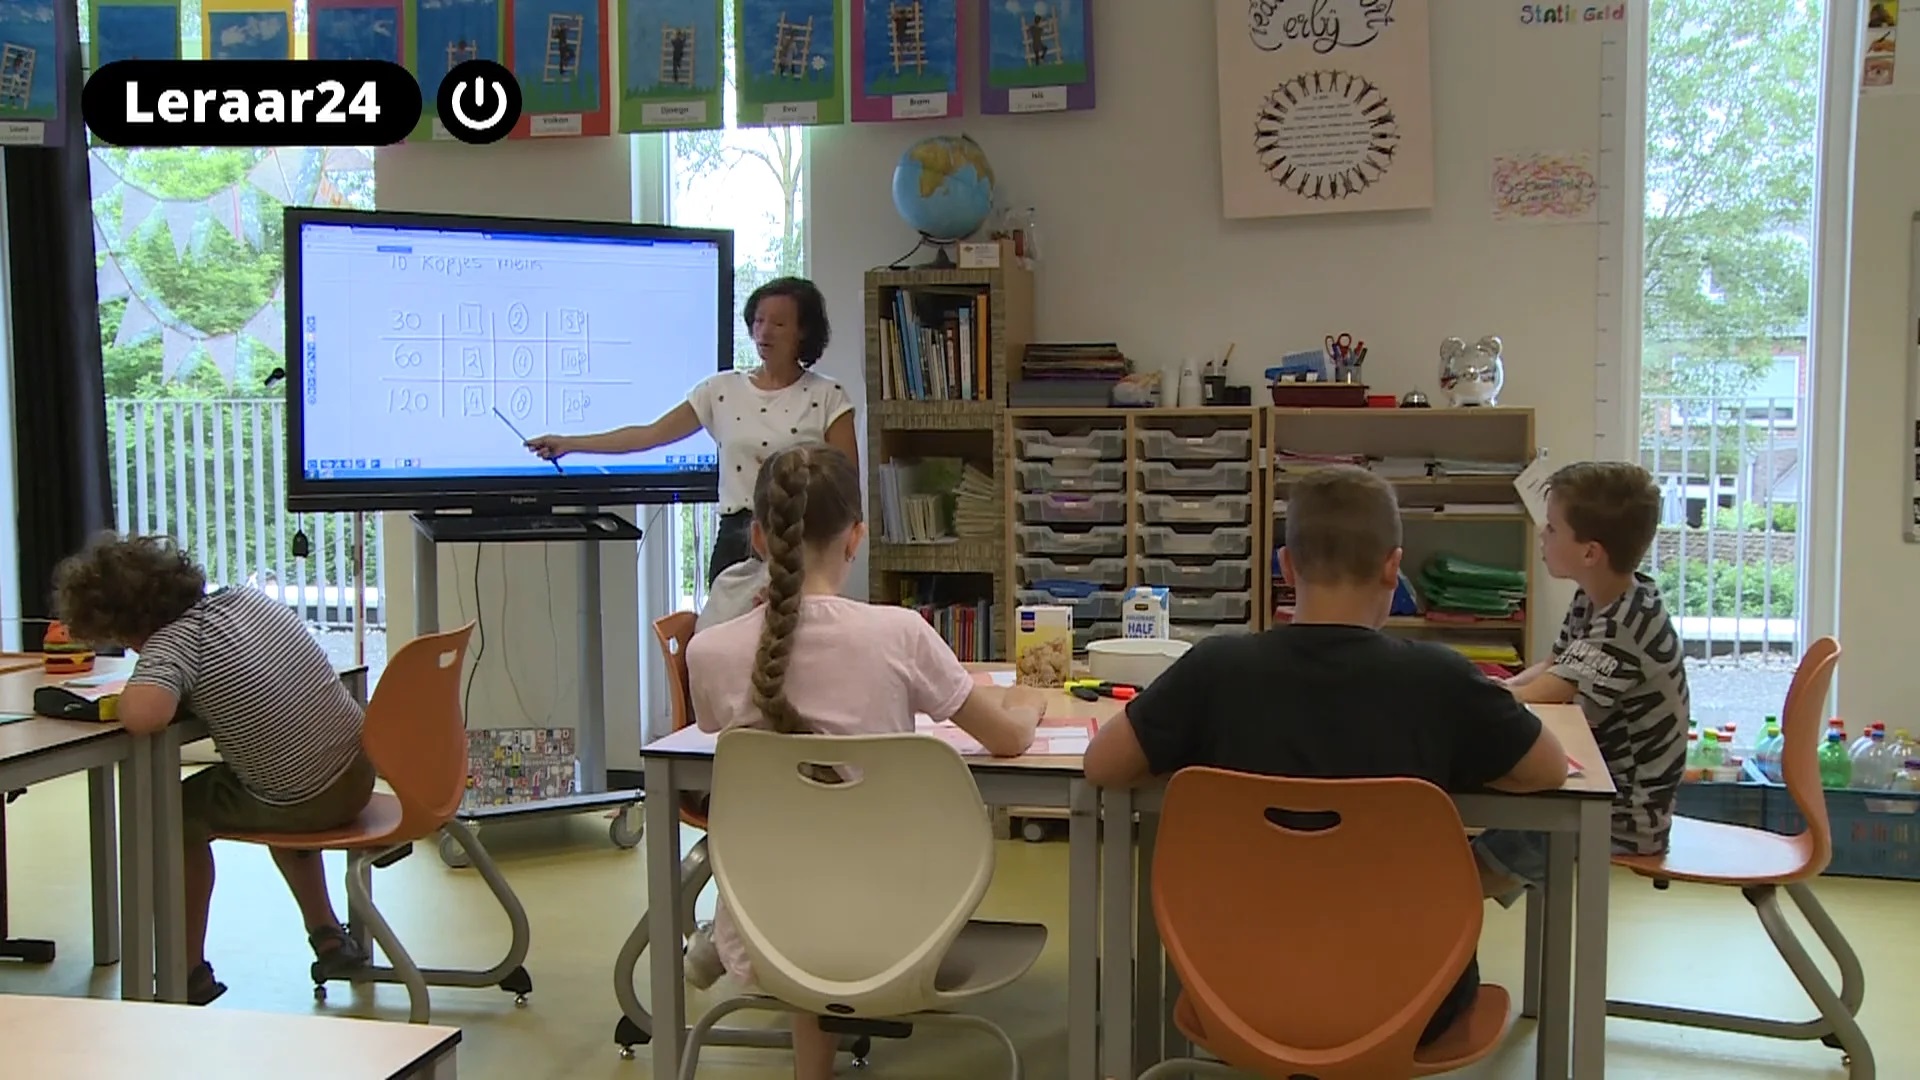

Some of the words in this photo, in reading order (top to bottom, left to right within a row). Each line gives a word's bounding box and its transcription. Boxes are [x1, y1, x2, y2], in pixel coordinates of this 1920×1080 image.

[391, 310, 422, 331] 30
[394, 343, 422, 368] 60
[388, 387, 429, 414] 120
[1128, 622, 1154, 635] HALF
